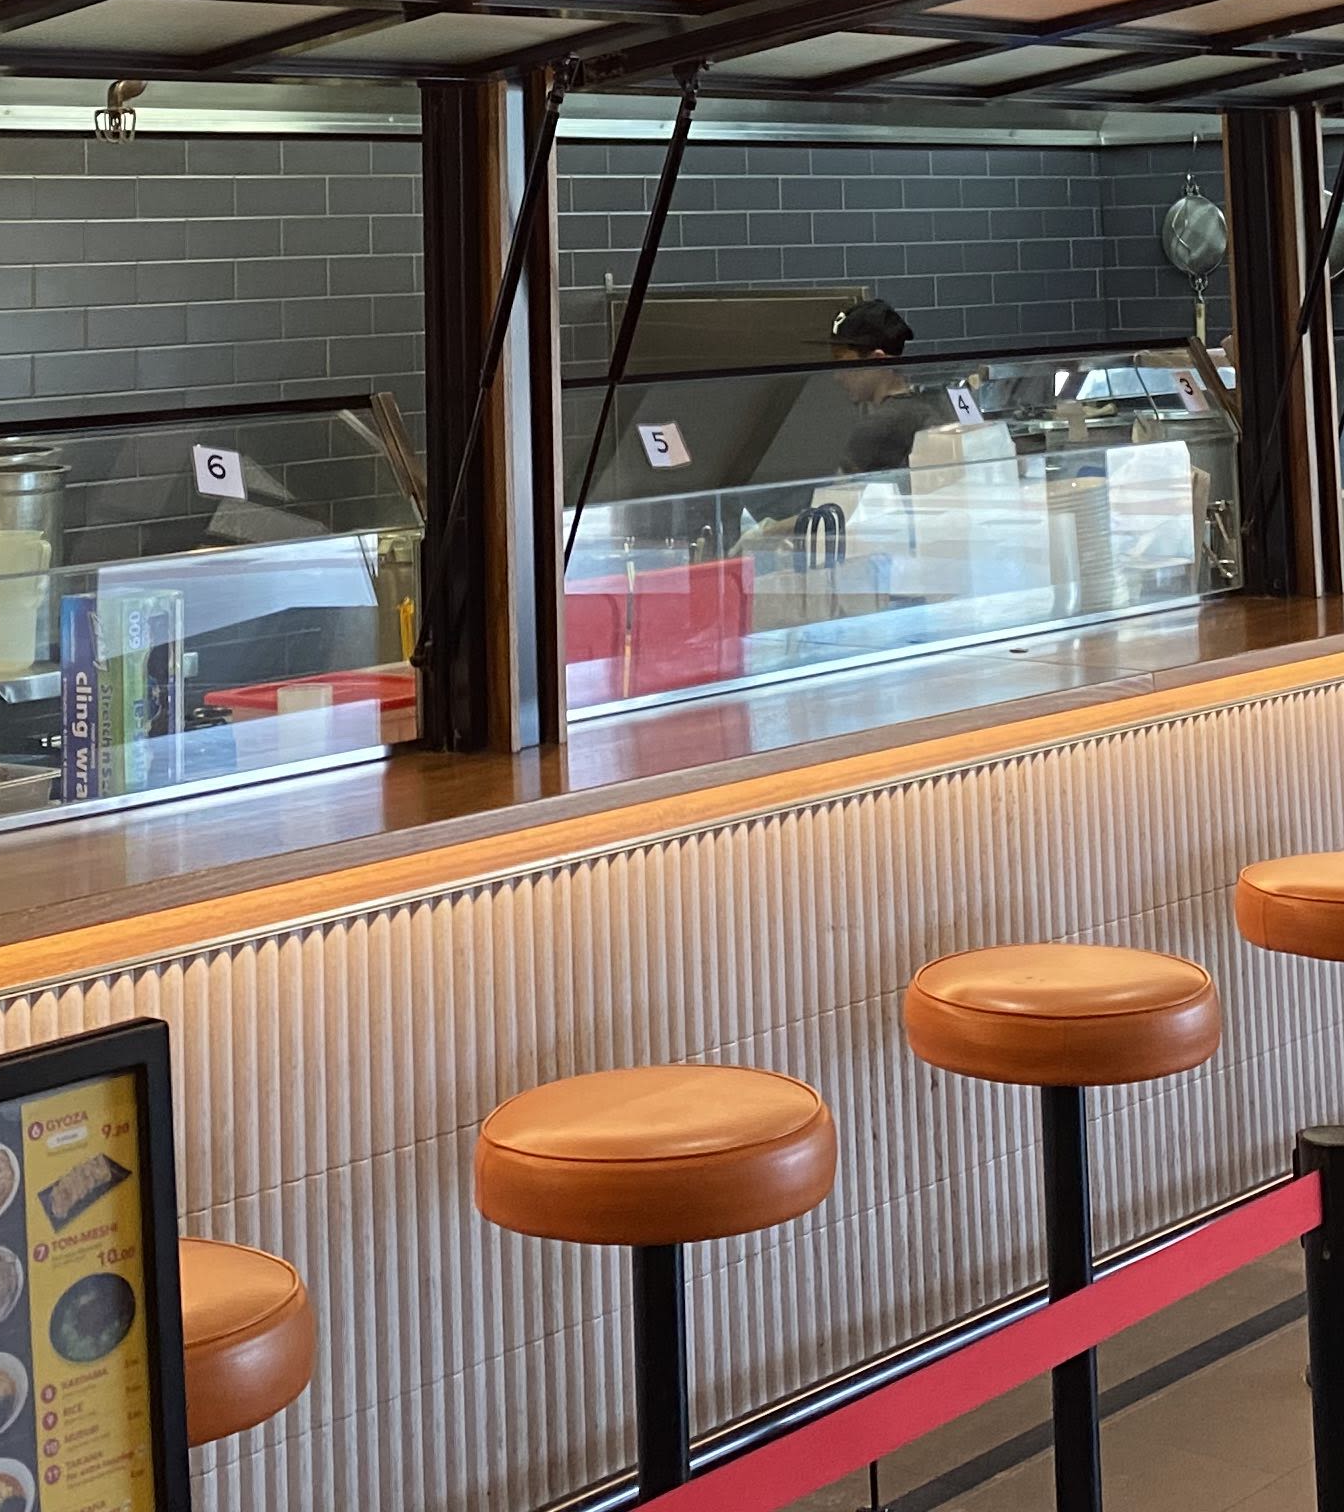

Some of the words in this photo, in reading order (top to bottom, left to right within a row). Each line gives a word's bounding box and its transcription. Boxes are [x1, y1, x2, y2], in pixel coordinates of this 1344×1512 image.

[1179, 377, 1194, 396] 3
[957, 394, 970, 414] 4
[652, 431, 669, 454] 5
[207, 454, 226, 480] 6
[72, 671, 93, 738] cling
[100, 684, 113, 749] Stretch
[75, 747, 90, 800] wra
[46, 1111, 89, 1131] GYOZA
